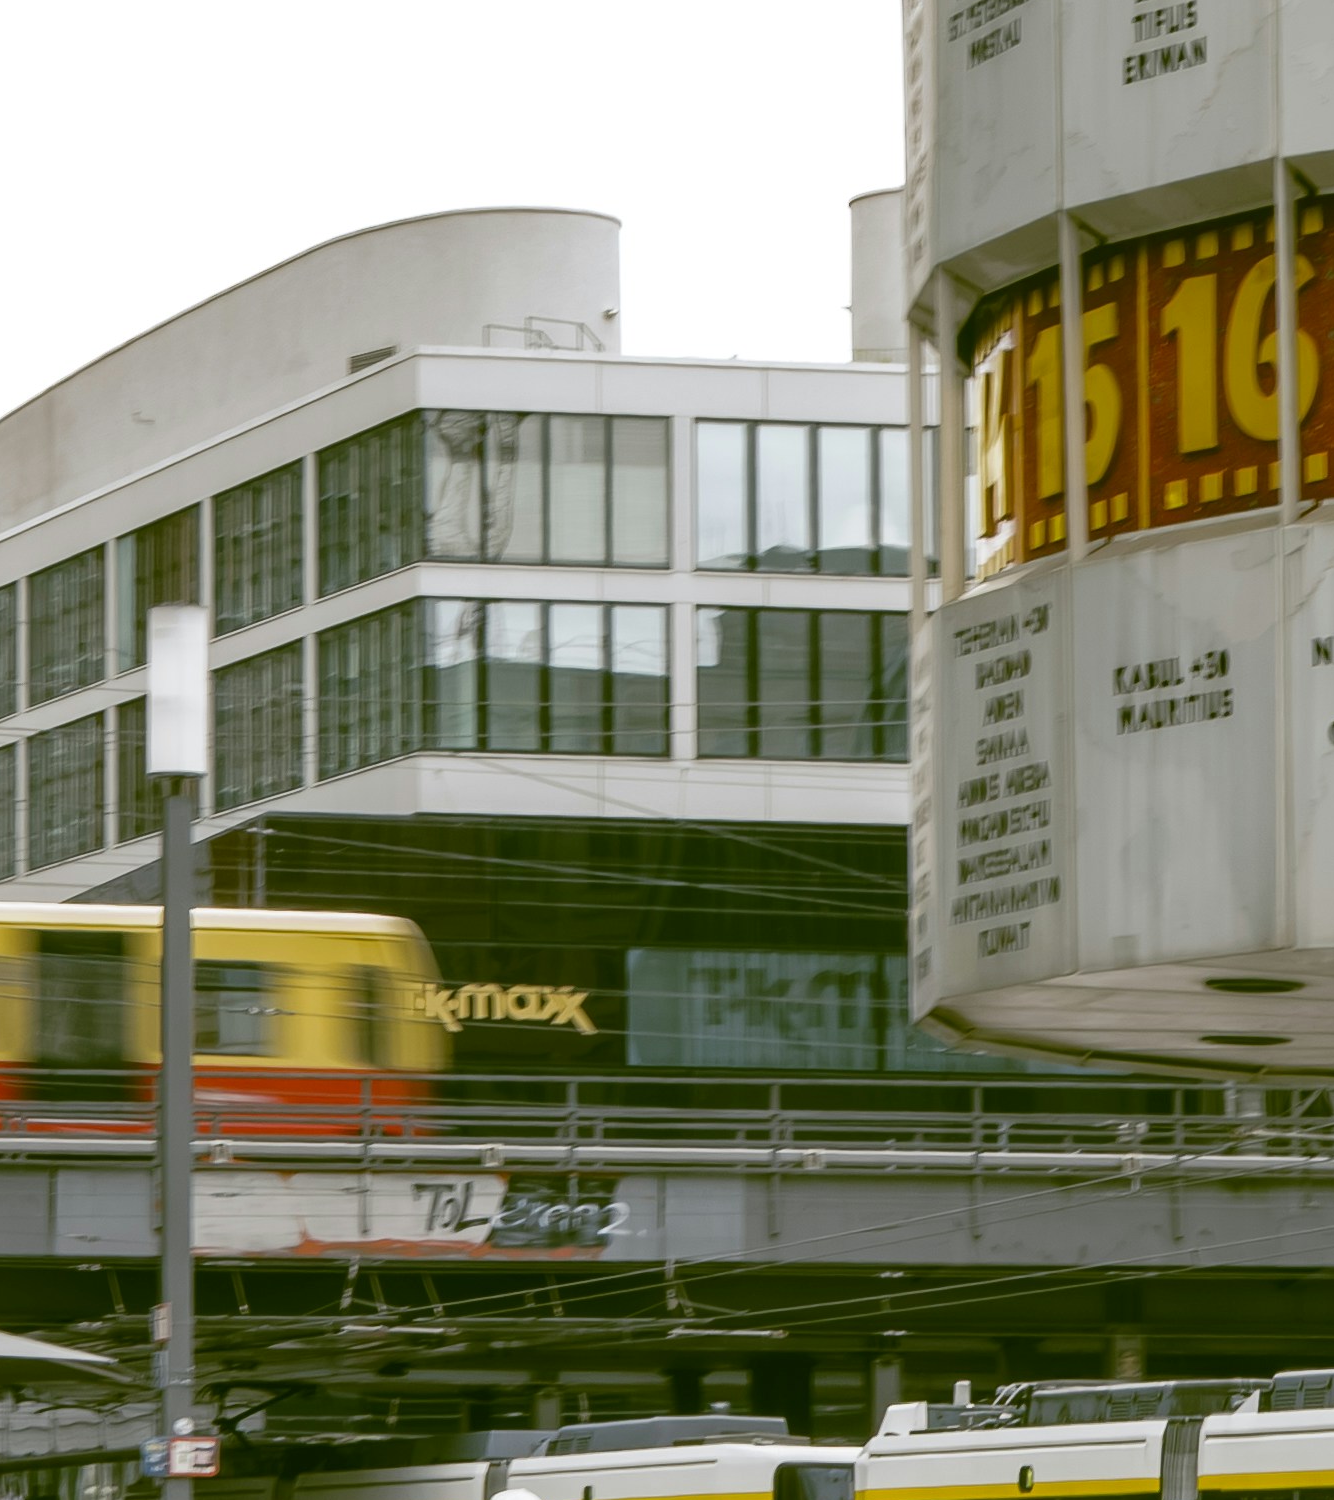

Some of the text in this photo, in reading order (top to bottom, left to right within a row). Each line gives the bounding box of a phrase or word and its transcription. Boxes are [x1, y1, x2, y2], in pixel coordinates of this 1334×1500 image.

[1132, 0, 1198, 43] TIFLIS
[1122, 35, 1208, 86] ERIWAN
[1159, 252, 1320, 454] 16
[1026, 301, 1123, 500] 15
[1113, 656, 1185, 696] KABUL
[1116, 688, 1234, 736] MAURITIUS
